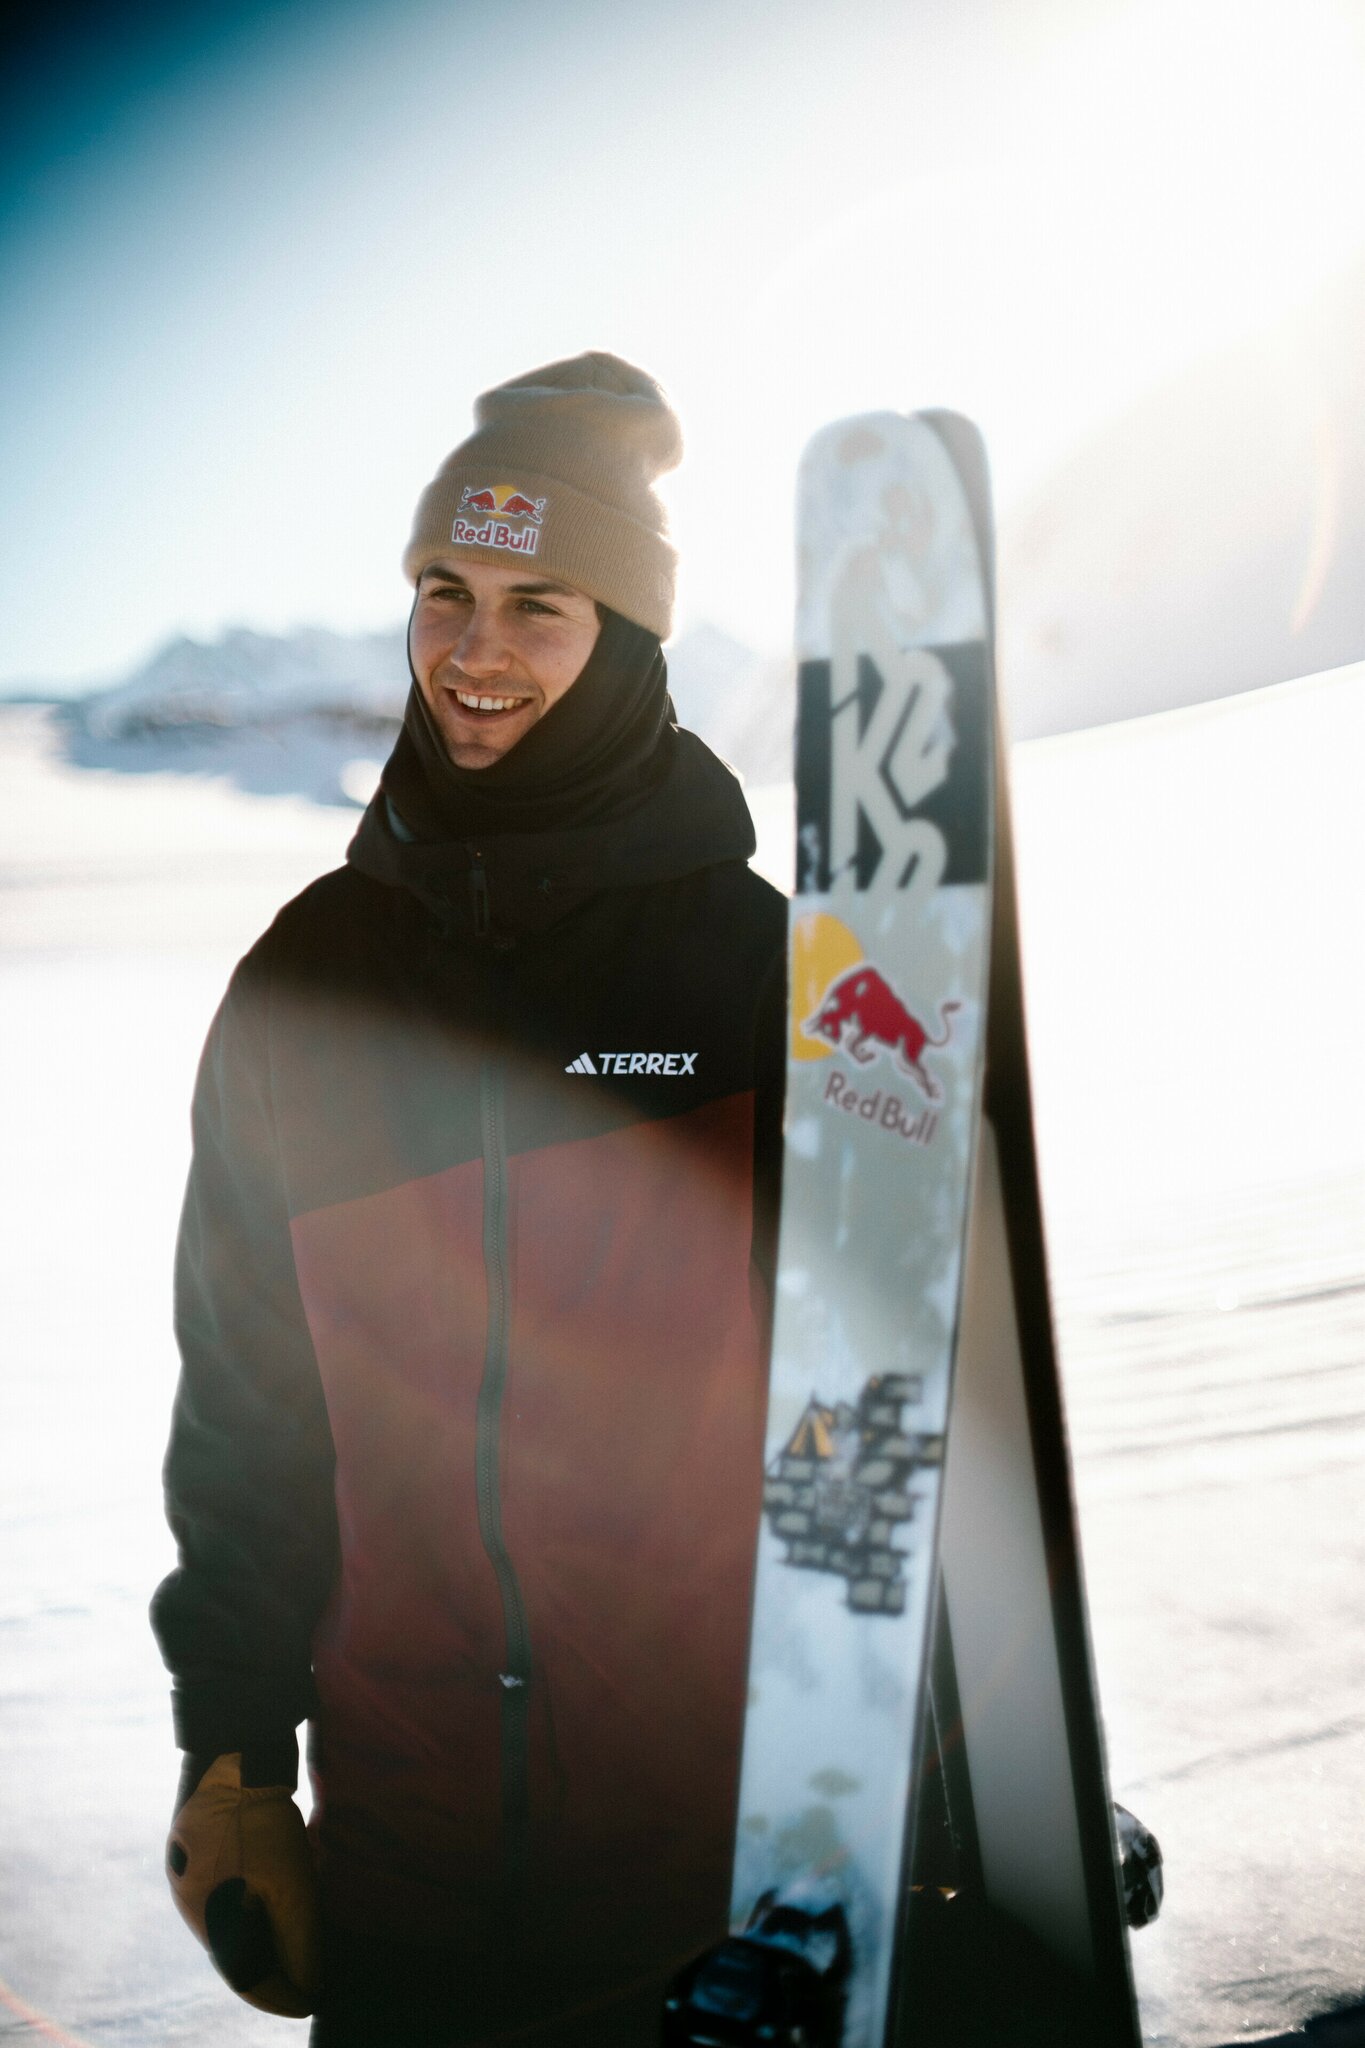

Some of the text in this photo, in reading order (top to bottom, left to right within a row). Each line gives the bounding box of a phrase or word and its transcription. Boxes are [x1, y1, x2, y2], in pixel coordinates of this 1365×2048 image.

[453, 520, 537, 552] Red Bull
[598, 1052, 699, 1076] TERREX
[824, 1071, 938, 1145] Red Bull
